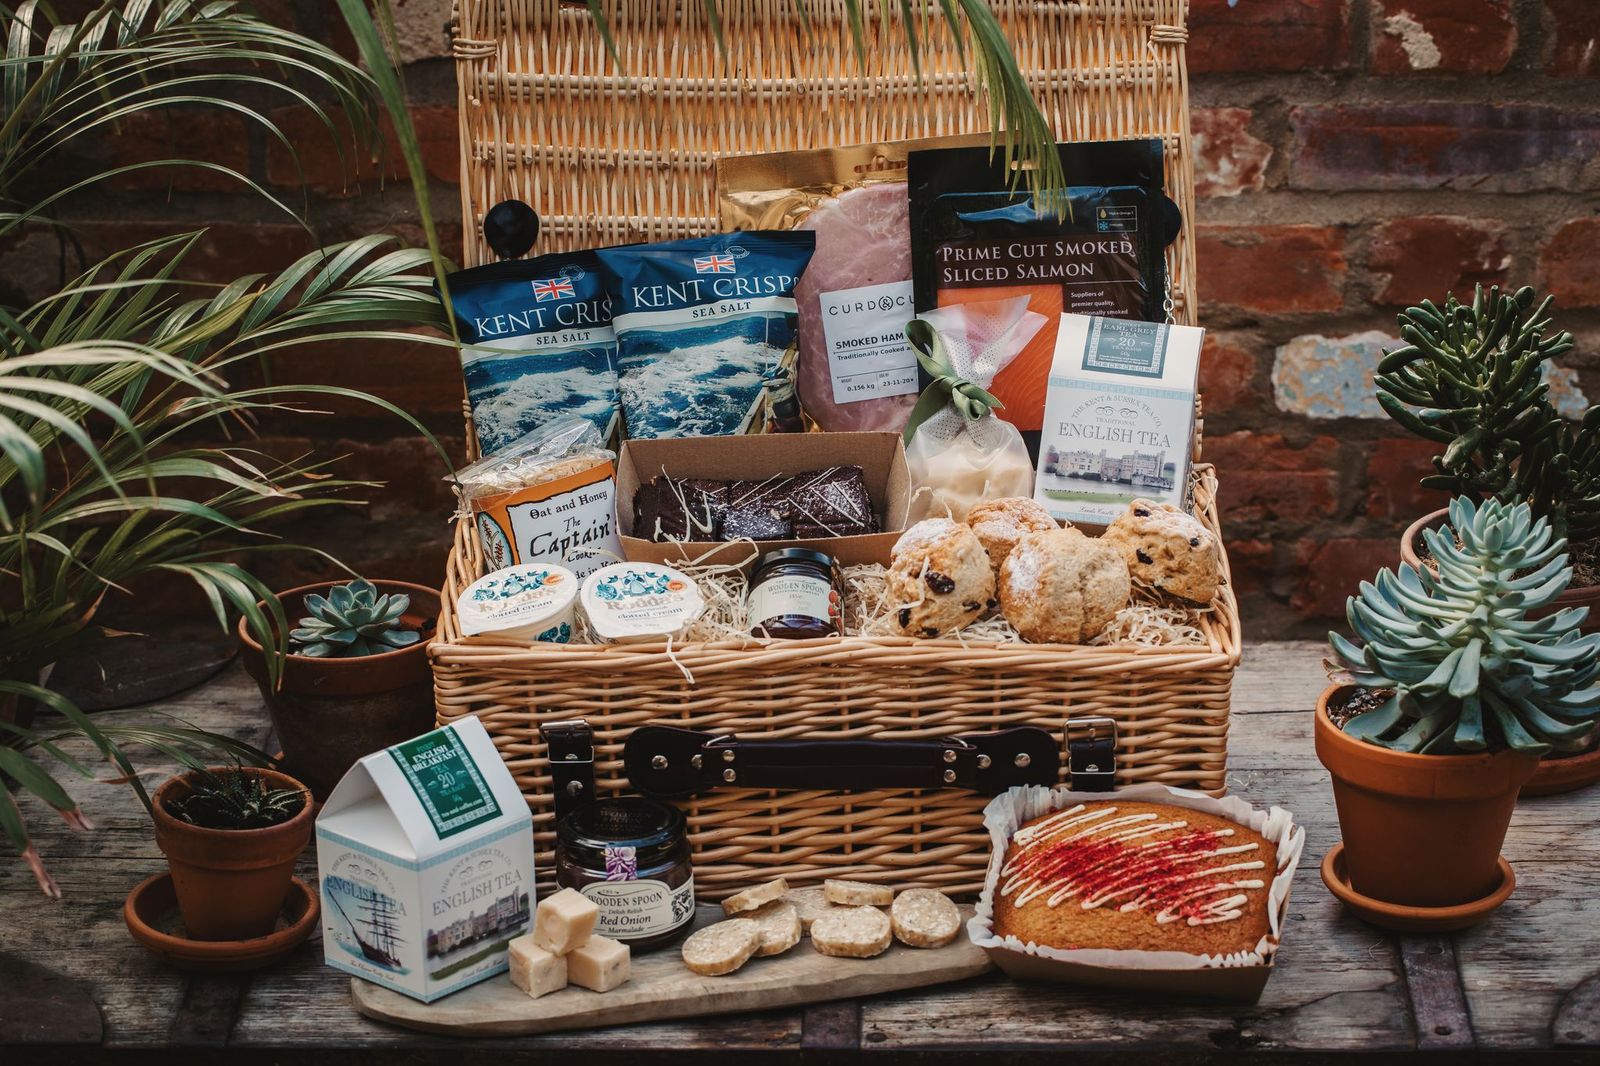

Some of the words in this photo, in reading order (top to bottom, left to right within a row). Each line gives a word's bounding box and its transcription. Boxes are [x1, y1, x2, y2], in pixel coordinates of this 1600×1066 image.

[942, 246, 1001, 262] PRIME
[1008, 243, 1048, 259] CUT
[1054, 240, 1133, 256] SMOKED
[943, 267, 1009, 283] SLICED
[1016, 263, 1095, 279] SALMON
[631, 279, 705, 309] KENT
[1070, 291, 1097, 299] Suppliers
[692, 306, 717, 319] SEA
[721, 301, 752, 315] SALT
[474, 307, 547, 338] KENT
[1103, 324, 1128, 332] EARL
[1129, 327, 1156, 335] GREY
[536, 334, 560, 346] SEA
[562, 331, 591, 343] SALT
[835, 336, 878, 350] SMOKED
[881, 332, 904, 343] HAM
[1119, 338, 1136, 347] 20
[837, 348, 879, 361] Traditionally
[880, 346, 905, 355] Cooked
[847, 383, 866, 392] 0.156
[1072, 405, 1085, 418] THE
[1084, 396, 1105, 408] KENT
[1058, 422, 1133, 443] ENGLISH
[1136, 430, 1171, 448] TEA
[530, 507, 552, 520] Oat
[555, 500, 577, 513] and
[579, 490, 608, 506] Honey
[563, 516, 581, 533] The
[530, 513, 618, 559] Captain'
[767, 582, 800, 593] WOODEN
[801, 582, 825, 594] SPOON
[522, 600, 553, 612] cream
[605, 594, 685, 610] Rodda's
[617, 611, 650, 620] clotted
[653, 607, 684, 617] cream
[411, 749, 458, 773] BREAKFAST
[412, 744, 450, 763] ENGLISH
[431, 764, 450, 775] TEA
[437, 772, 456, 789] 20
[326, 873, 381, 903] ENGLISH
[432, 879, 493, 917] ENGLISH
[494, 868, 523, 891] TEA
[632, 891, 663, 906] SPOON
[600, 915, 618, 926] Red
[620, 914, 652, 926] Onion
[607, 926, 645, 934] Marmalade
